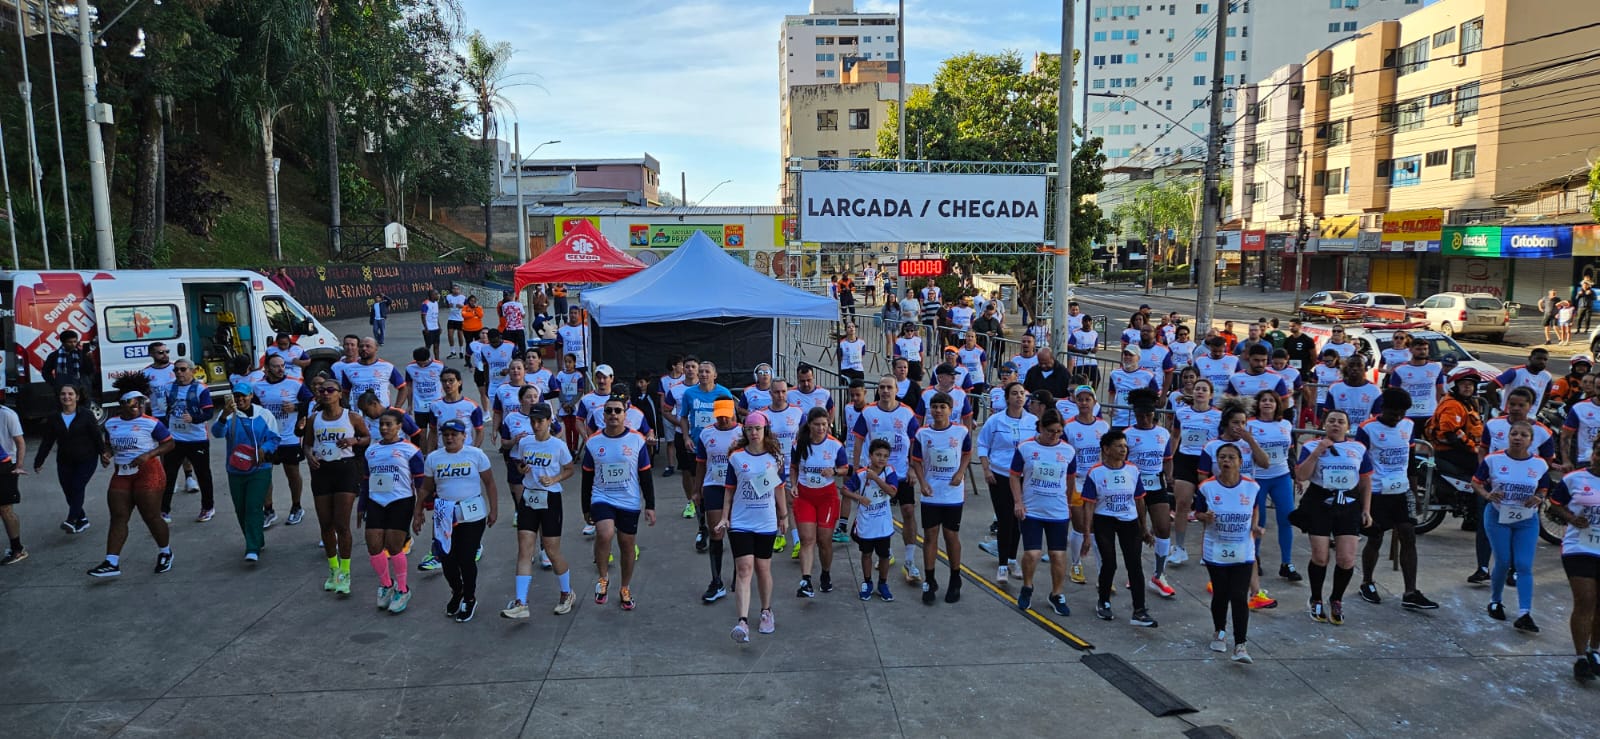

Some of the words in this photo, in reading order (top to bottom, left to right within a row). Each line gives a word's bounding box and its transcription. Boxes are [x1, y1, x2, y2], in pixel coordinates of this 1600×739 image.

[808, 198, 913, 217] LARGADA
[919, 199, 931, 218] /
[938, 199, 1039, 218] CHEGADA
[1463, 234, 1488, 246] destak
[1511, 235, 1558, 248] Ortobom
[701, 415, 711, 423] 23
[936, 454, 949, 462] 54
[607, 468, 624, 477] 159
[1039, 467, 1055, 476] 138
[377, 478, 383, 486] 4
[763, 478, 770, 486] 6
[810, 475, 821, 484] 83
[1114, 475, 1126, 484] 53
[1390, 481, 1401, 490] 63
[872, 489, 884, 498] 45
[528, 496, 540, 504] 66
[467, 503, 478, 512] 15
[1508, 511, 1522, 520] 26
[1221, 549, 1236, 558] 34
